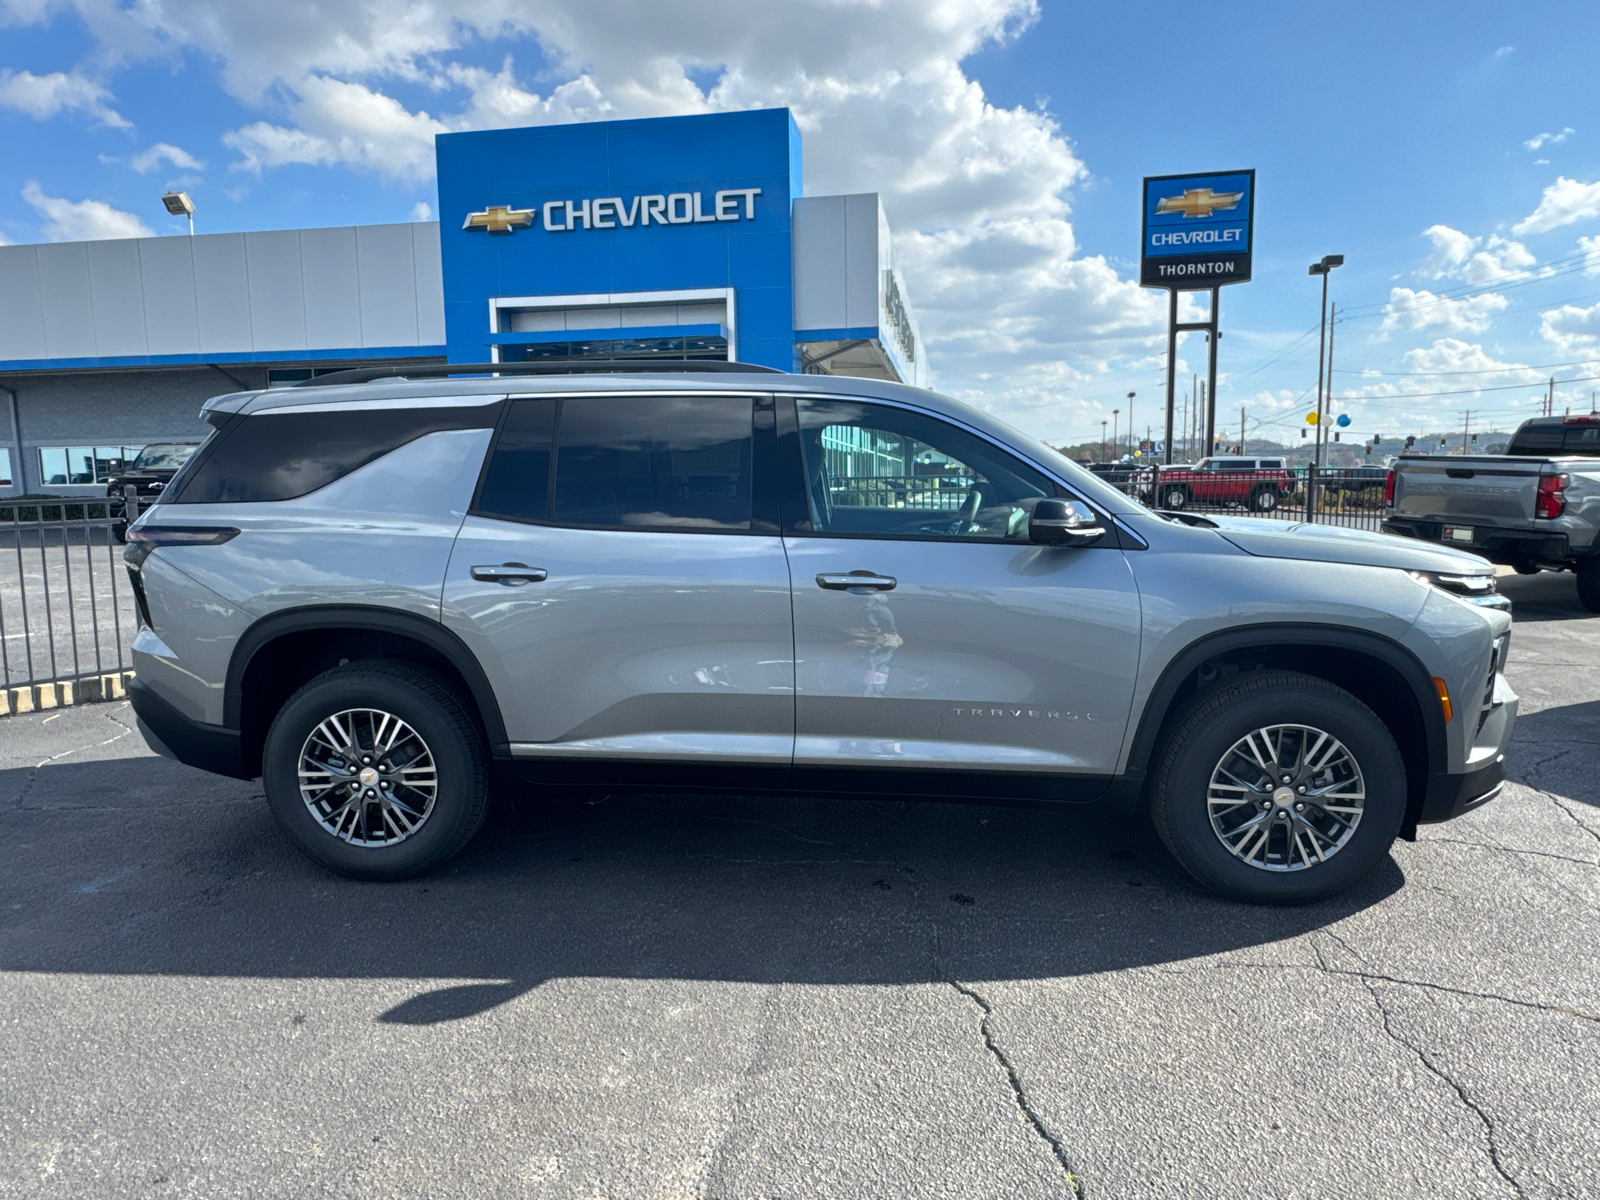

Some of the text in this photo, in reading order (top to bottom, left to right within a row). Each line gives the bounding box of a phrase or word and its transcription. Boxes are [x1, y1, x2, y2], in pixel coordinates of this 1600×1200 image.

[543, 188, 762, 231] CHEVROLET
[1152, 229, 1242, 246] CHEVROLET
[1159, 262, 1234, 276] THORNTON
[953, 708, 1100, 721] TRAVERSE
